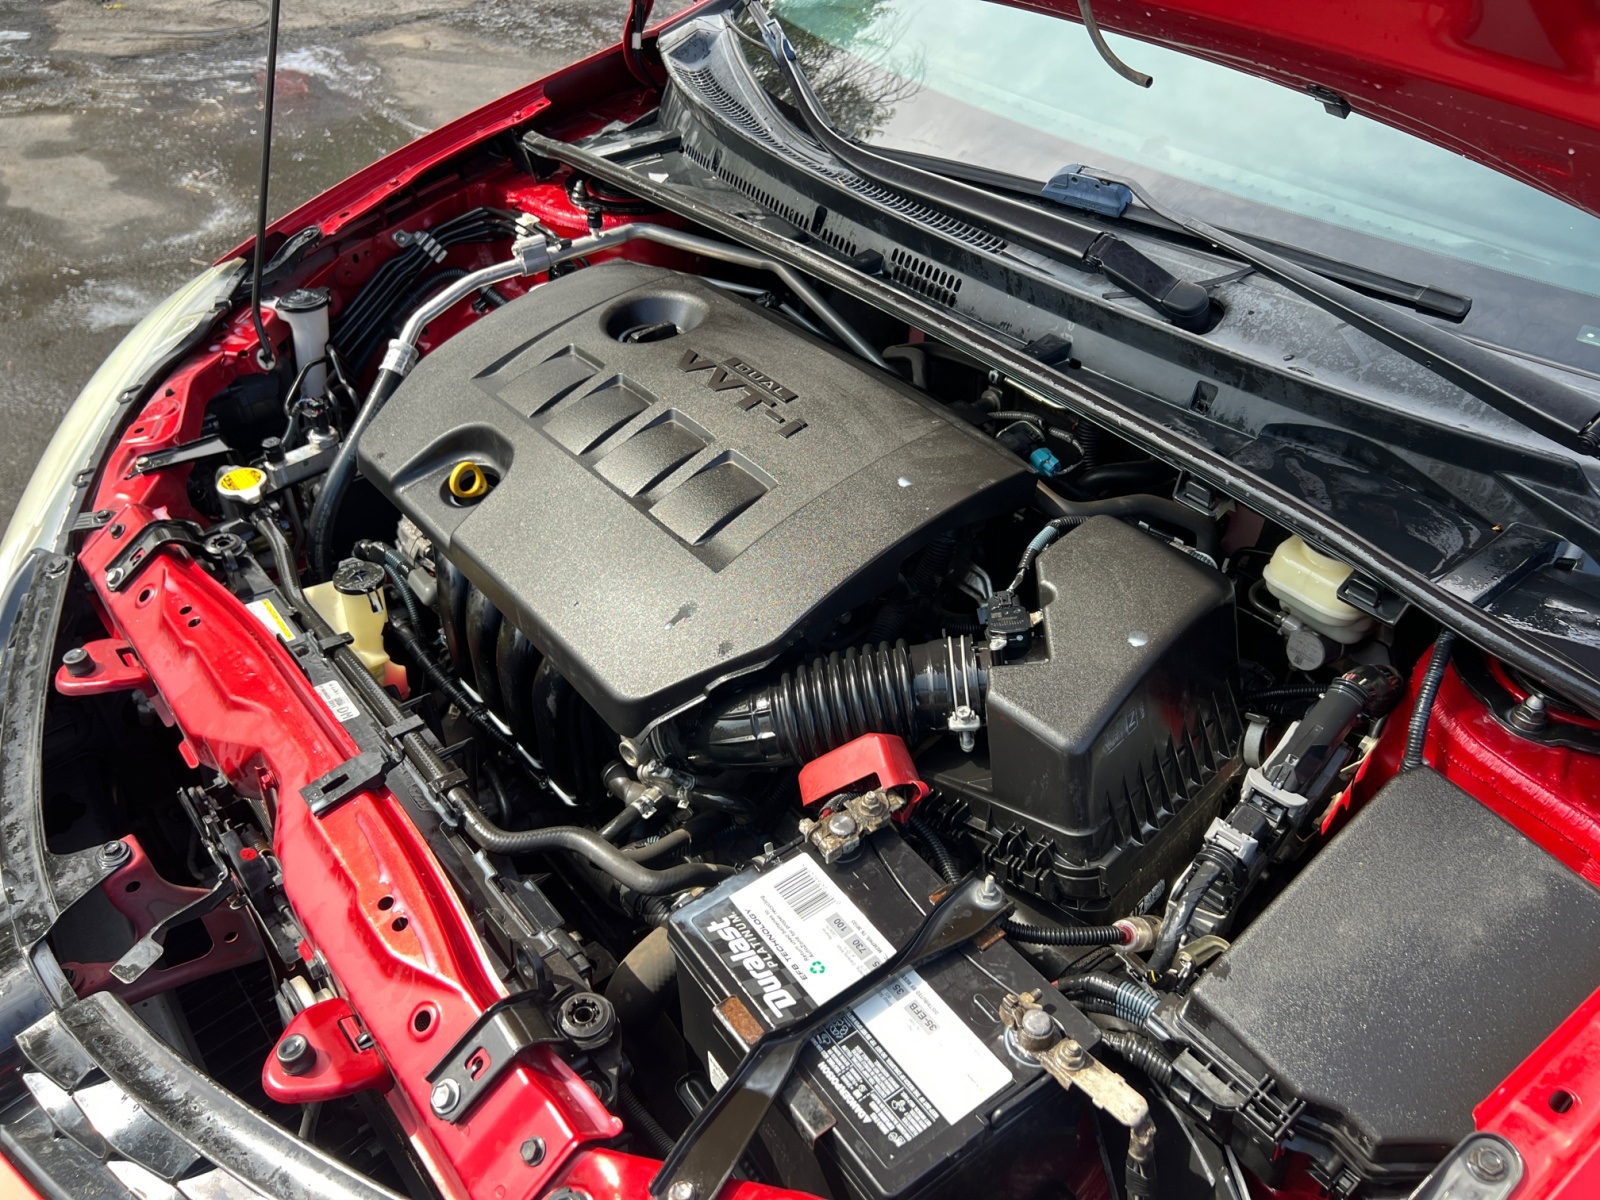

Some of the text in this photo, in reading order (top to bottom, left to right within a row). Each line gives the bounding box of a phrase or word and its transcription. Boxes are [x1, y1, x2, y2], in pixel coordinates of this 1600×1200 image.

[735, 361, 783, 397] DUAL
[832, 917, 848, 932] 100
[744, 908, 808, 980] EFB TECHNOLOGY
[851, 938, 867, 953] 730
[706, 916, 797, 1018] Duralast
[891, 983, 905, 995] 35
[907, 1001, 938, 1031] 35-EFB
[817, 1061, 868, 1119] DANGER/POISON
